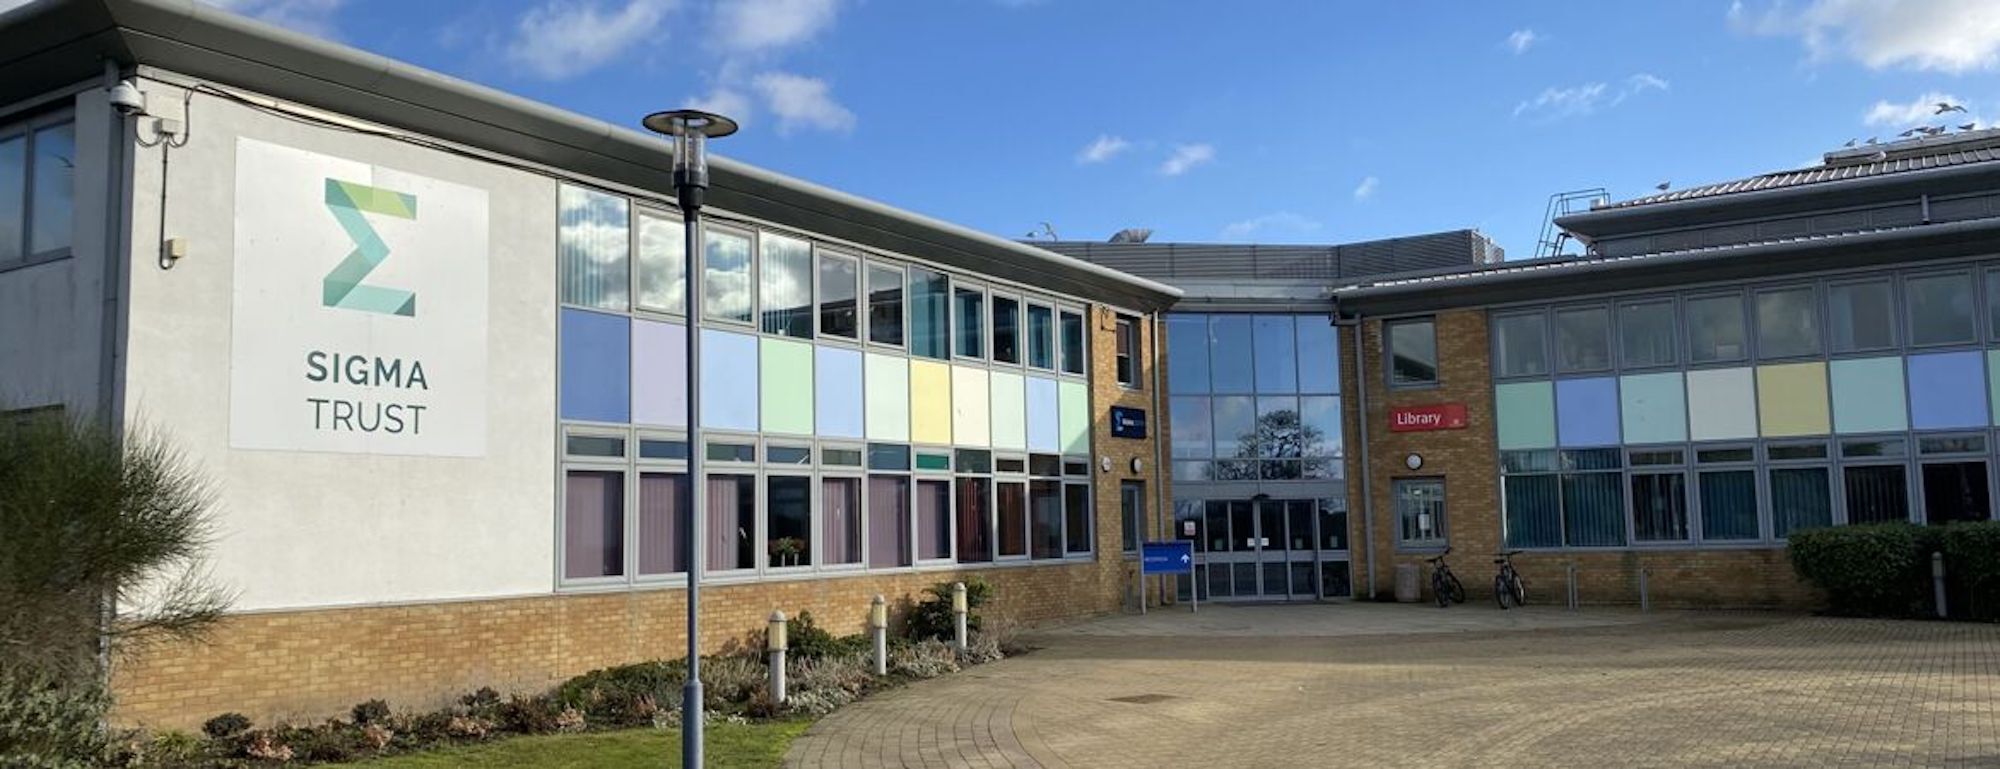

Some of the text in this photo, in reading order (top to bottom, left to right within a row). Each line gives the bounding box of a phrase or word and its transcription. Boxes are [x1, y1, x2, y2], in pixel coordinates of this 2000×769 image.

[306, 351, 428, 390] SIGMA
[307, 398, 426, 435] TRUST
[1397, 412, 1441, 427] Library
